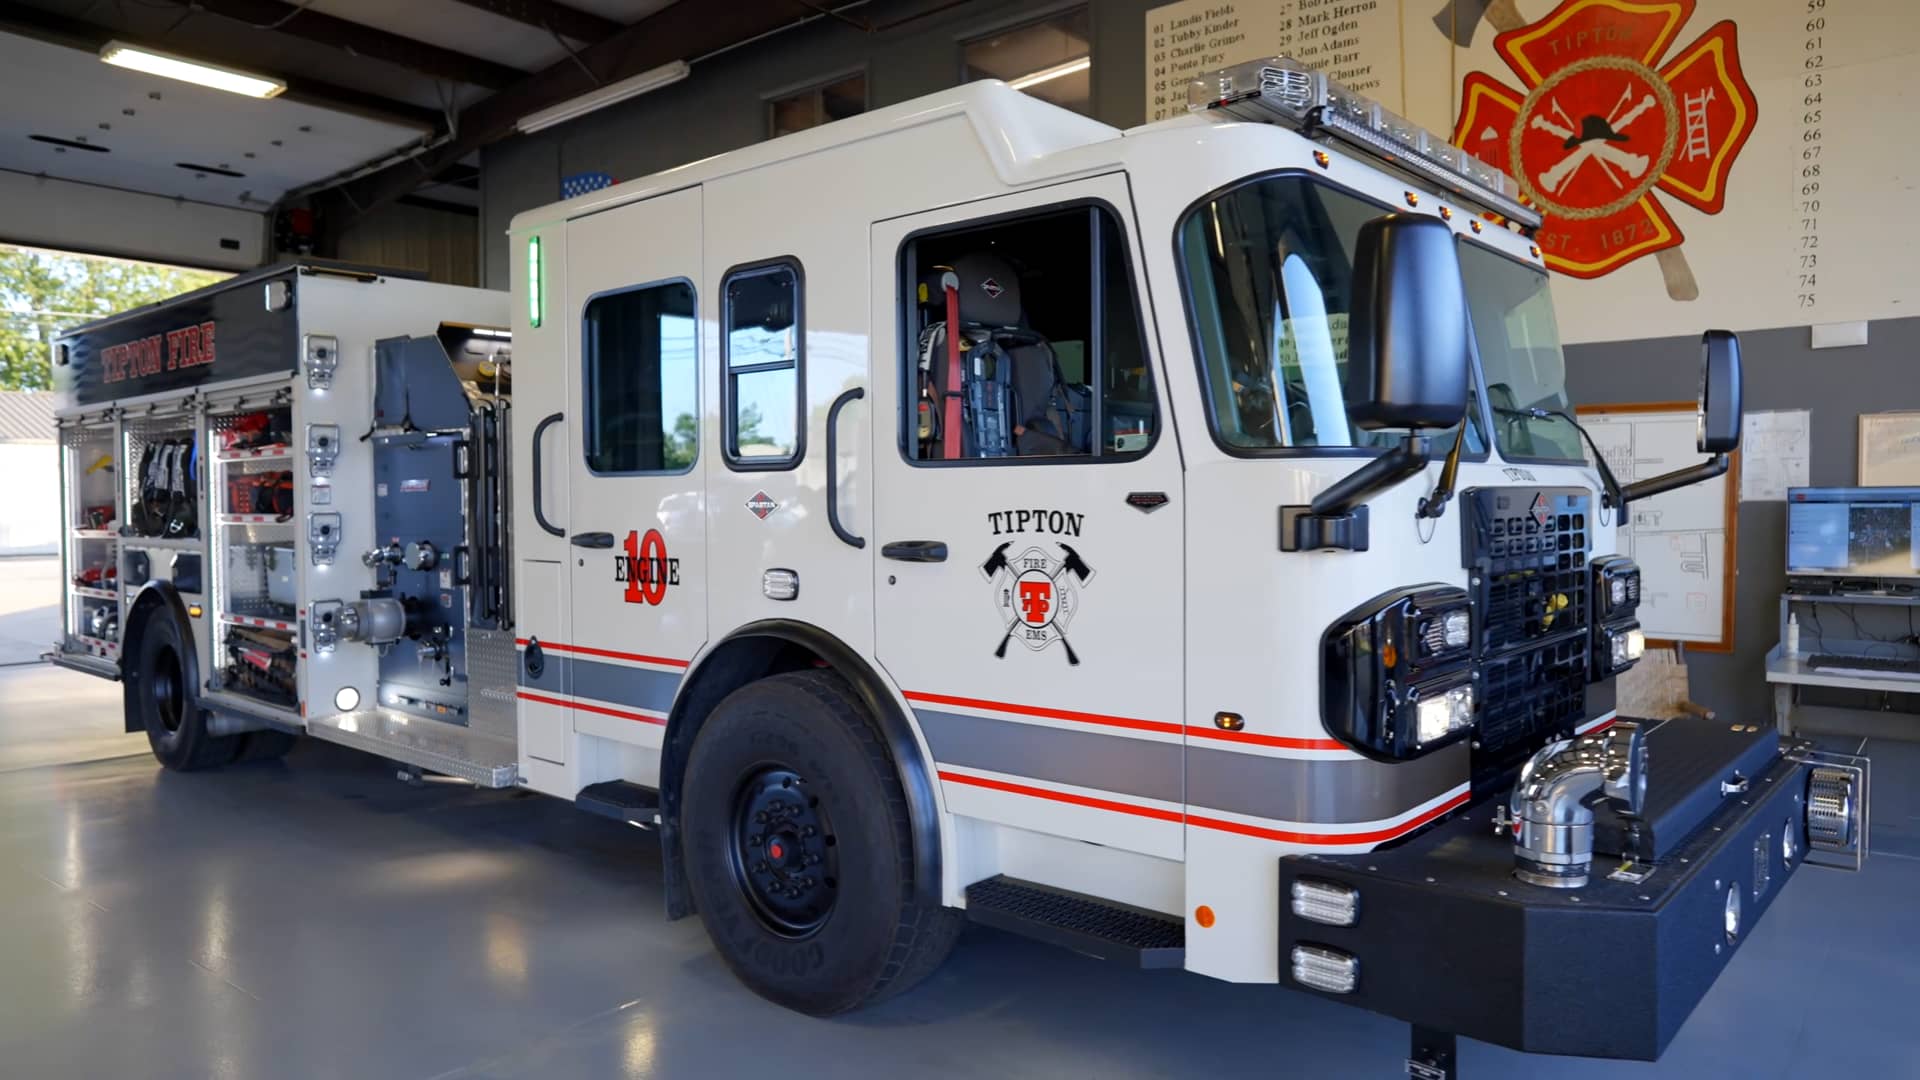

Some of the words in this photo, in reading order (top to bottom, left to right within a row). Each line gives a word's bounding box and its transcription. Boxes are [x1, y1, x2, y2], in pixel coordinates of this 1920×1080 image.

[1205, 4, 1234, 20] Fields
[1298, 11, 1330, 28] Mark
[1333, 0, 1377, 19] Herron
[1807, 0, 1825, 14] 59
[1171, 29, 1201, 44] Tubby
[1205, 18, 1239, 36] Kinder
[1297, 27, 1319, 41] Jeff
[1322, 20, 1358, 36] Ogden
[1806, 17, 1825, 32] 60
[1170, 42, 1206, 58] Charlie
[1208, 32, 1245, 49] Grimes
[1320, 37, 1359, 53] Adams
[1805, 37, 1822, 50] 61
[1805, 55, 1823, 69] 62
[1154, 66, 1166, 77] 04
[1154, 80, 1166, 92] 05
[1805, 73, 1822, 88] 63
[1804, 92, 1822, 106] 64
[1804, 110, 1821, 124] 65
[1803, 128, 1821, 142] 66
[1803, 146, 1821, 160] 67
[1802, 164, 1820, 178] 68
[1802, 182, 1820, 195] 69
[1802, 199, 1820, 213] 70
[1801, 218, 1816, 231] 71
[1601, 220, 1654, 250] 1872
[1801, 235, 1818, 249] 72
[1800, 254, 1816, 268] 73
[1799, 273, 1816, 288] 74
[1798, 293, 1816, 309] 75
[101, 334, 162, 384] TIPTON
[166, 321, 216, 371] FIRE
[988, 509, 1085, 537] TIPTON
[623, 528, 668, 606] 10
[1023, 558, 1048, 569] FIRE
[614, 555, 680, 587] ENGINE
[1025, 629, 1048, 641] EMS
